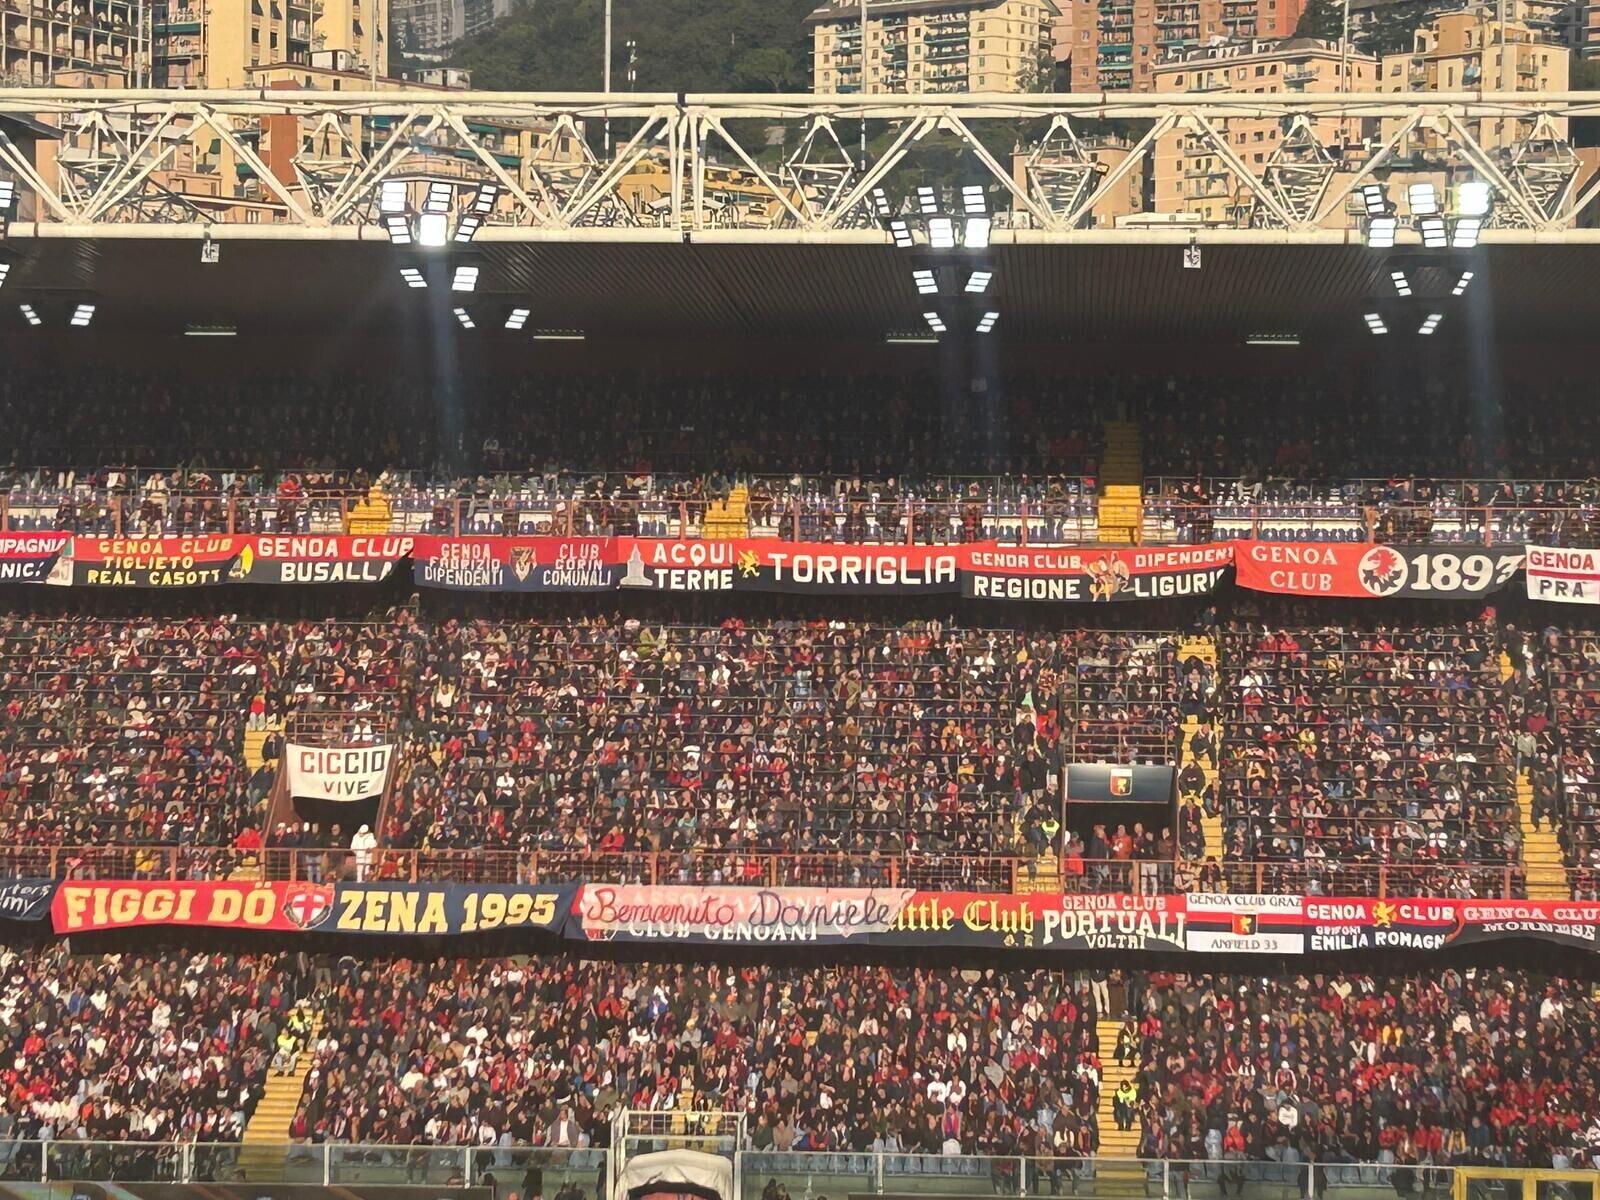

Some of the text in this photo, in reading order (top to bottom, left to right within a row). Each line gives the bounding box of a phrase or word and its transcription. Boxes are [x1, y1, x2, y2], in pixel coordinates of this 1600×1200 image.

[98, 538, 233, 554] GENOA CLUB
[258, 537, 414, 558] GENOA CLUB
[441, 543, 600, 560] GENOA CLUB
[653, 543, 733, 566] ACQUI
[1251, 545, 1338, 566] GENOA
[103, 556, 194, 570] TIGLIETO
[767, 553, 956, 585] TORRIGLIA
[971, 551, 1029, 568] GENOA
[1034, 555, 1081, 569] CLUB
[1530, 550, 1594, 570] GENOA
[87, 570, 136, 585] REAL
[424, 566, 611, 586] DIPENDENTI COMUNALI
[653, 569, 733, 590] TERME
[1269, 570, 1333, 591] CLUB
[1410, 553, 1526, 592] 1893
[974, 575, 1080, 599] REGIONE
[300, 750, 386, 774] CICCIO
[324, 779, 369, 795] VIVE
[63, 881, 559, 933] FIGGI DÖ ZENA 1995
[587, 888, 890, 927] Benvenuto Daniele
[1062, 895, 1166, 911] GENOA CLUB
[1189, 894, 1231, 905] GENOA
[1234, 895, 1266, 906] CLUB
[963, 899, 1034, 934] Club
[1307, 904, 1455, 920] GENOA CLUB
[1463, 906, 1548, 921] GENOA
[1042, 910, 1186, 950] PORTUALI
[1482, 921, 1596, 941] MORNESE
[1085, 934, 1146, 949] VOLTRI
[1311, 933, 1369, 951] EMILIA
